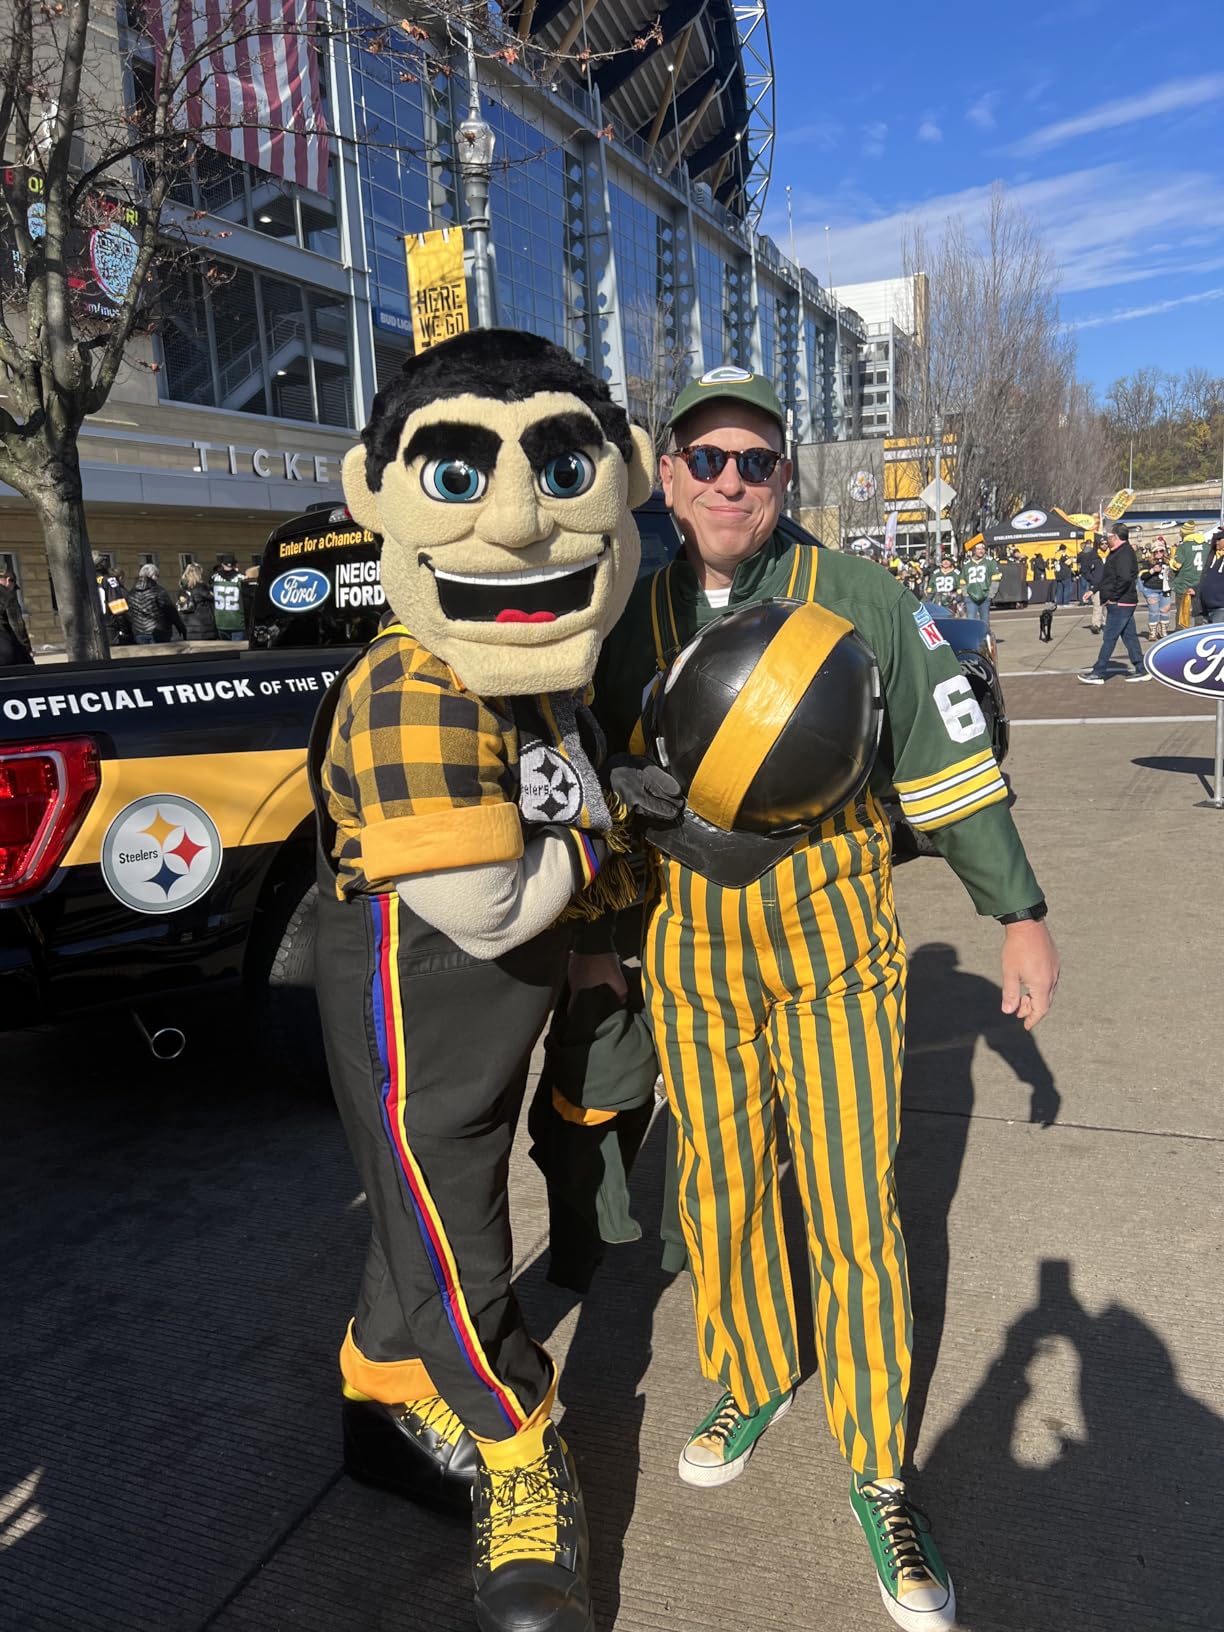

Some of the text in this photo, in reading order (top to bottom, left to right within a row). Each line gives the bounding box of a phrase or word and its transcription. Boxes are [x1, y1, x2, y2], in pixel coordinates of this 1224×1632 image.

[416, 283, 463, 315] HERE
[380, 312, 396, 327] BUD
[419, 312, 465, 339] WE GO
[192, 441, 344, 483] TICKE
[280, 541, 303, 558] Enter
[304, 536, 318, 552] for
[318, 537, 325, 549] a
[325, 531, 361, 548] Chance
[340, 560, 381, 585] NEIG
[1193, 552, 1203, 571] 4
[935, 576, 954, 592] 28
[968, 566, 987, 583] 23
[213, 586, 240, 611] 52
[280, 575, 319, 605] Ford
[340, 585, 386, 608] FORD
[3, 671, 340, 721] OFFICIAL TRUCK OF THE P
[933, 674, 987, 743] 6
[119, 849, 159, 864] Steelers
